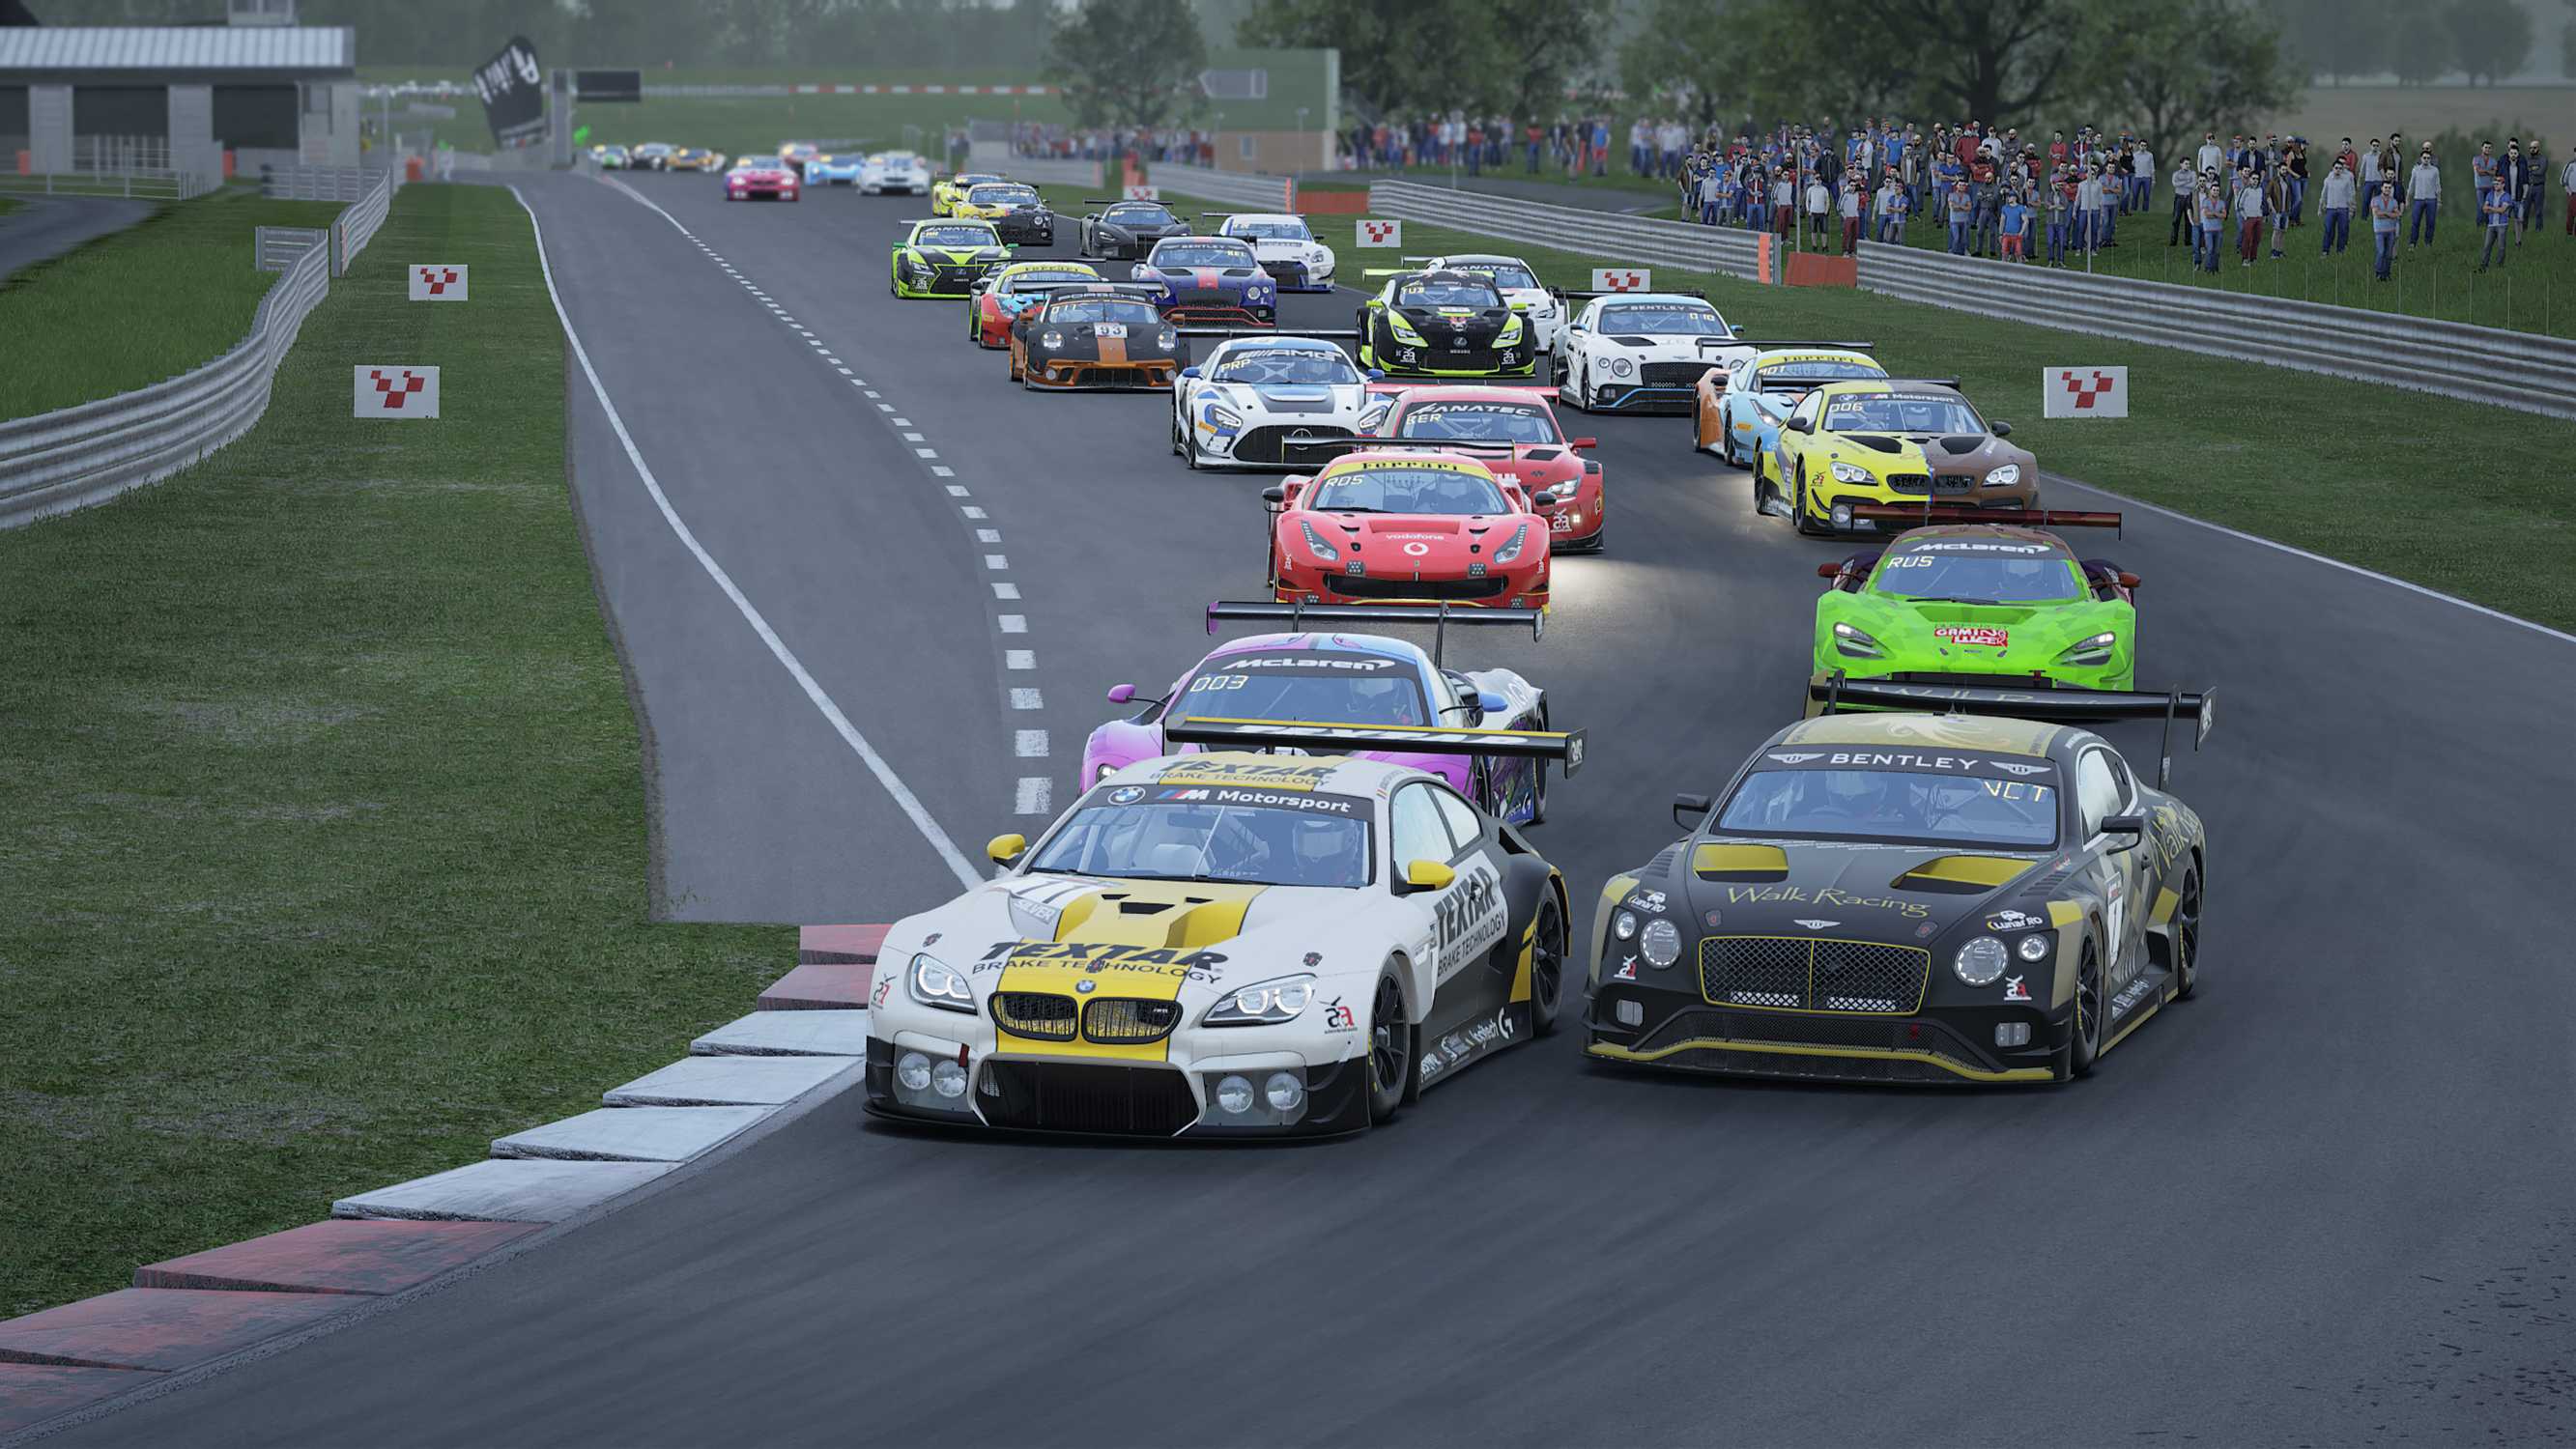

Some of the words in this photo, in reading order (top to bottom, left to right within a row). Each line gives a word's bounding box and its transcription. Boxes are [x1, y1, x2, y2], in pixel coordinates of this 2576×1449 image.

[1101, 326, 1122, 335] 93
[1220, 359, 1251, 373] PRP
[1407, 403, 1532, 416] FANATEC
[1829, 403, 1863, 413] 006
[1406, 413, 1442, 426] BER
[1911, 543, 2050, 554] McLaren
[1887, 555, 1934, 569] RUS
[1221, 658, 1395, 671] McLaren
[1189, 674, 1249, 692] 003
[1159, 760, 1338, 778] TEXTAR
[1830, 753, 1979, 770] BENTLEY
[1150, 771, 1213, 780] BRAKE
[1215, 773, 1330, 787] TECHNOLOGY
[1216, 789, 1352, 812] Motorsport
[1433, 866, 1497, 952] TEXTAR
[1728, 886, 1808, 904] Walk
[1812, 888, 1932, 918] Racing
[981, 941, 1229, 971] TEXTAR
[972, 959, 1051, 975] BRAKE
[1059, 959, 1222, 984] TEHNOLOGY
